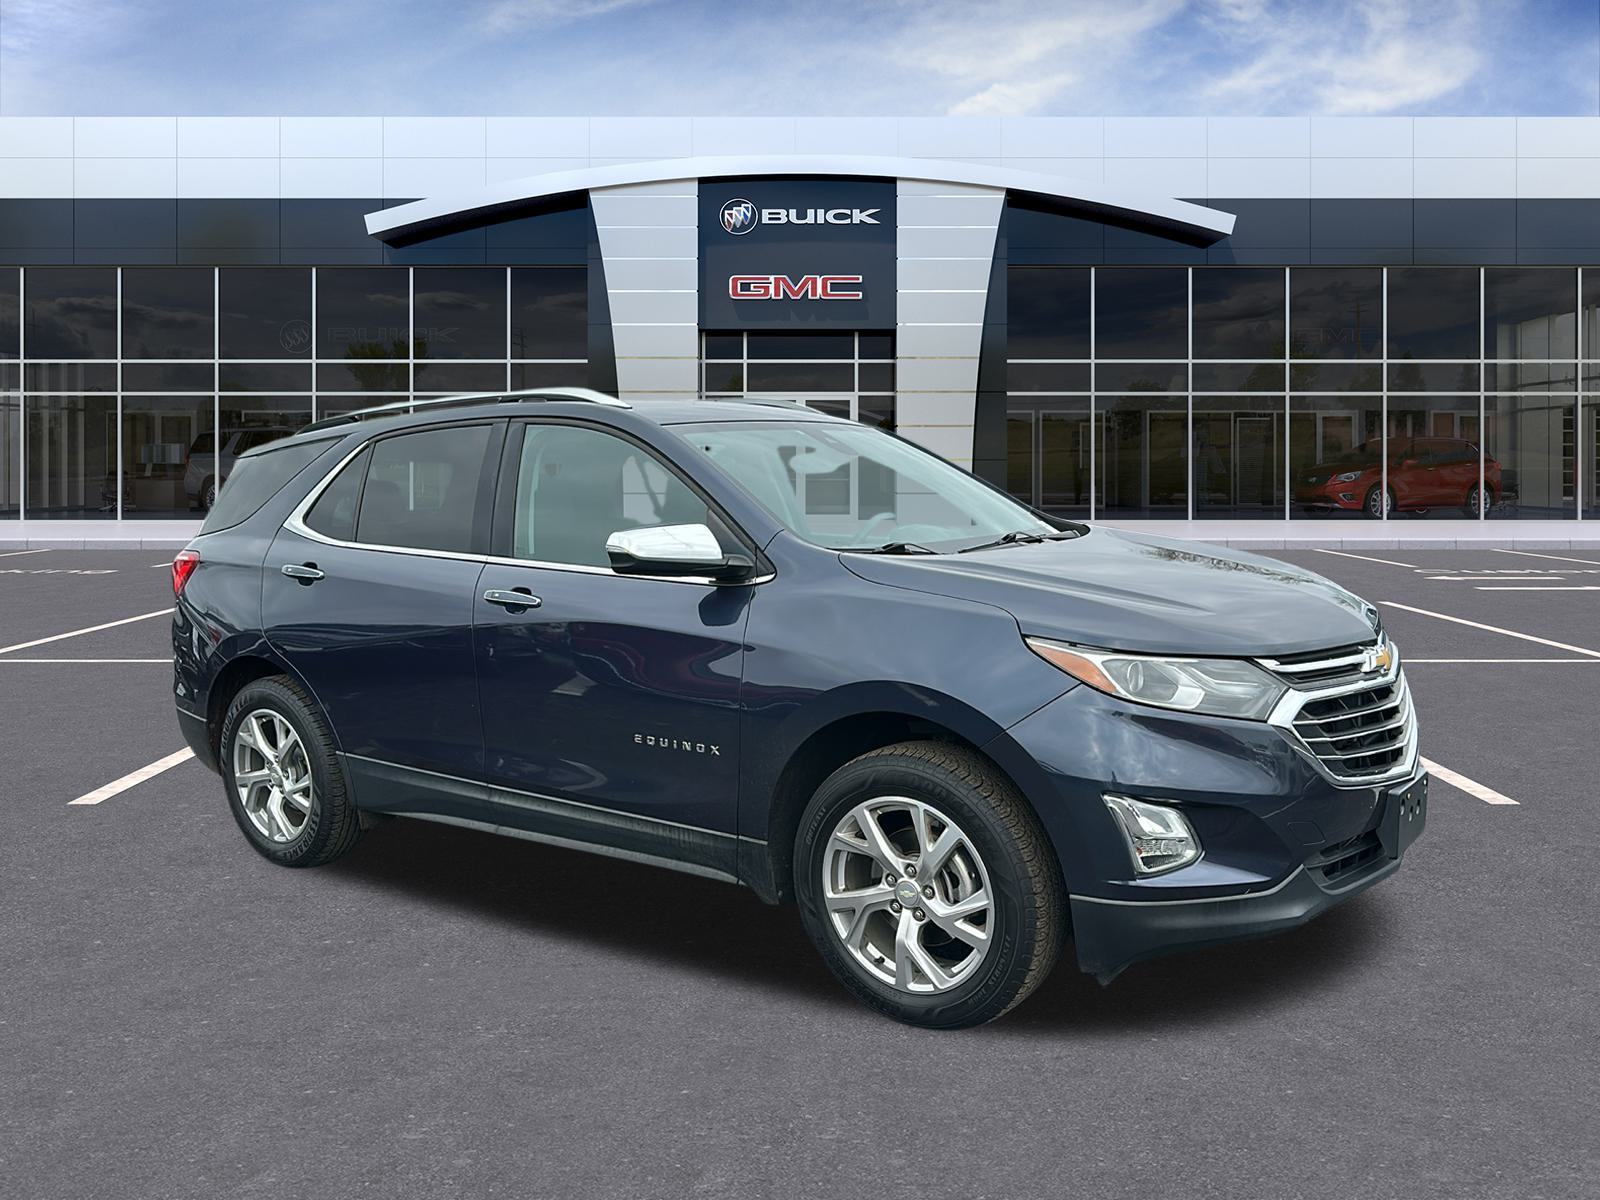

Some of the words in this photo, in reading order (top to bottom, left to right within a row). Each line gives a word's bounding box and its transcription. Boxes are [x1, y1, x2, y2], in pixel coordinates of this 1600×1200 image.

[761, 208, 881, 225] BUICK
[729, 275, 863, 300] GMC
[633, 733, 720, 756] EQUINOX
